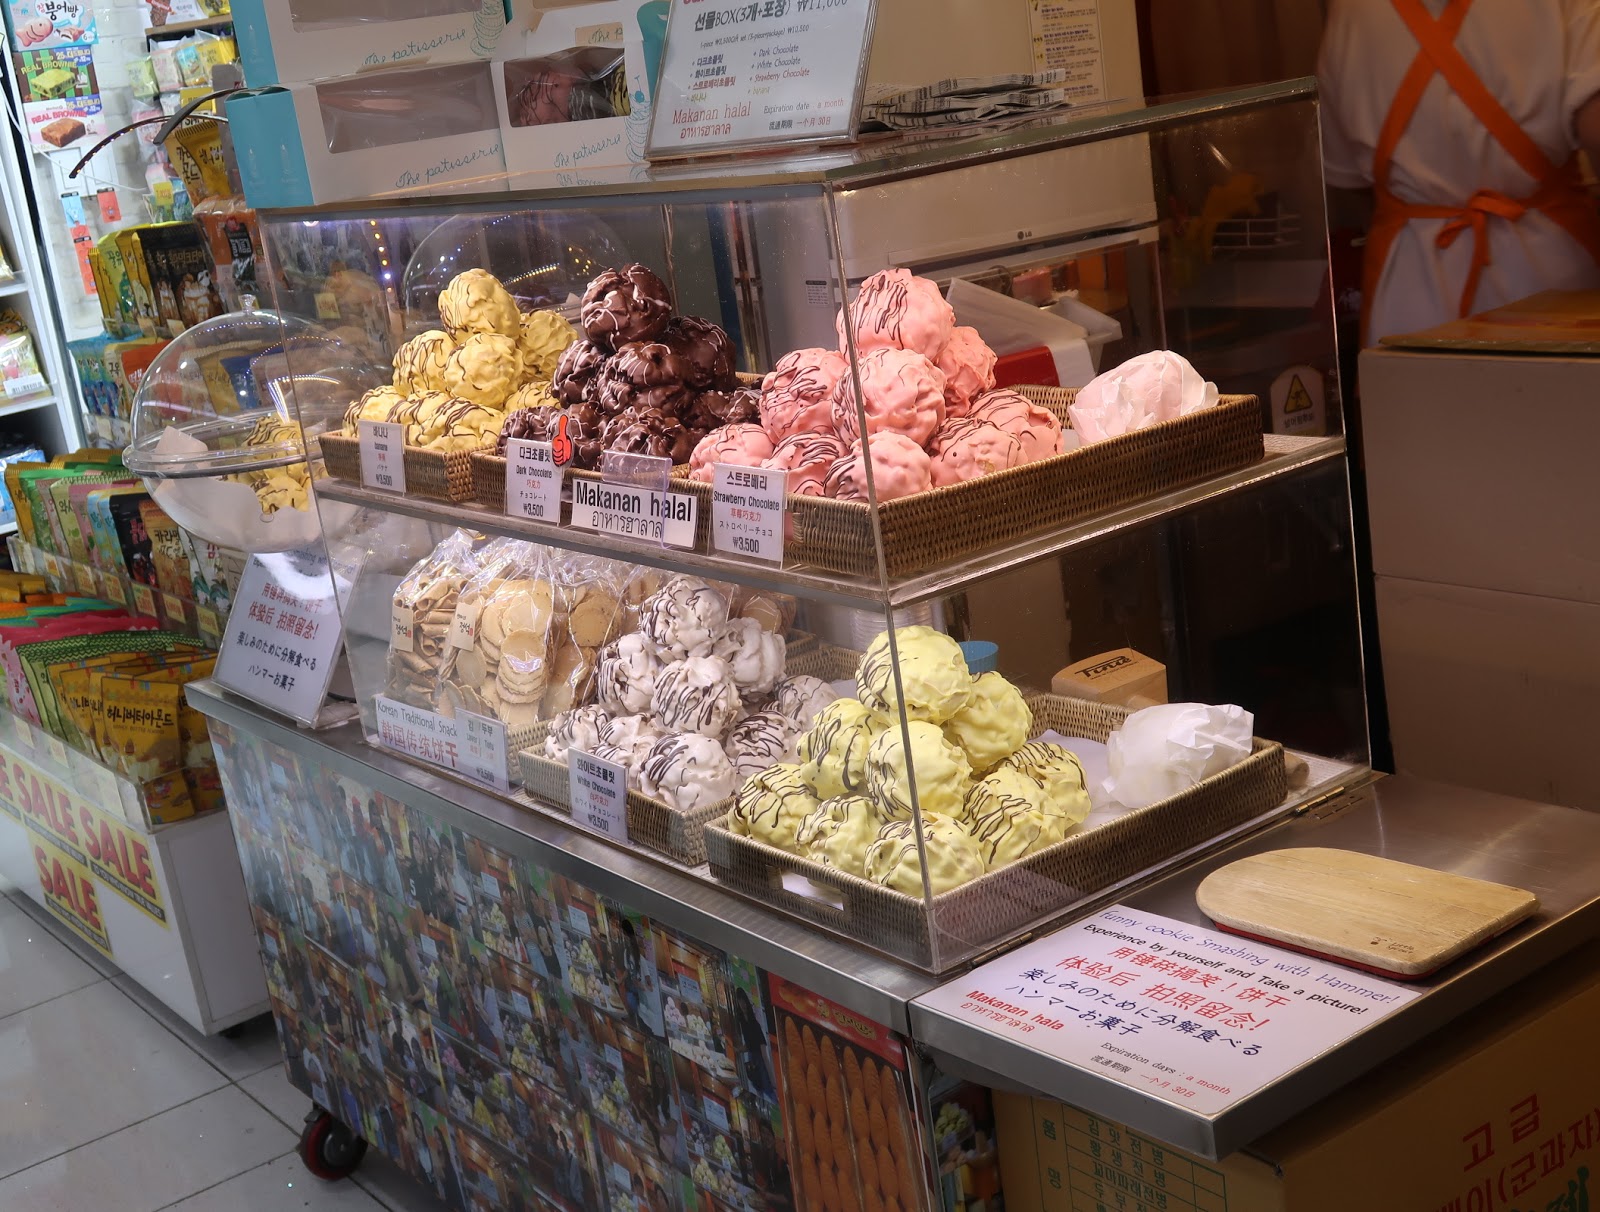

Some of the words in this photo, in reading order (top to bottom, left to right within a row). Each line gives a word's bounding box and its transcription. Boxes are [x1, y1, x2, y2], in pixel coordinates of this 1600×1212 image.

[45, 1, 79, 20] 붕어빵
[391, 27, 467, 60] patisserie
[759, 49, 770, 58] Dark
[773, 43, 799, 55] Chocolate
[20, 65, 41, 75] REAL
[42, 60, 77, 69] BROWNIE
[754, 71, 780, 82] Strawberry
[783, 67, 810, 78] Chocolate
[757, 60, 772, 70] White
[774, 56, 800, 67] Chocolate
[31, 114, 52, 124] REAL
[52, 110, 88, 119] BROWNIE
[672, 107, 718, 125] Makanan
[724, 101, 751, 119] halal
[764, 104, 793, 115] Expiration
[796, 102, 810, 111] date
[824, 98, 844, 108] month
[554, 151, 569, 168] The
[572, 134, 622, 166] patisserie
[395, 170, 422, 188] The
[426, 143, 501, 179] patisserie
[372, 426, 388, 439] 바나나
[376, 473, 392, 486] ₩3,500
[516, 465, 526, 475] Dark
[528, 466, 552, 478] Chocolate
[726, 471, 768, 491] 스트로베리
[519, 490, 547, 501] チョコレート
[526, 479, 541, 489] 巧克力
[523, 503, 544, 517] ₩3,500
[576, 481, 641, 514] Makanan
[650, 492, 692, 522] halal
[713, 491, 746, 506] Strawberry
[748, 496, 780, 511] Chocolate
[730, 507, 762, 522] 草莓巧克力
[719, 519, 773, 537] ストロベリーチョコ
[732, 536, 760, 554] ₩3,500
[248, 601, 275, 626] 体验后
[236, 631, 317, 671] 楽しみのために分解食べる
[248, 664, 295, 692] ハンマーお菓子
[107, 705, 174, 728] 허니버터아몬드
[377, 699, 399, 720] Korean
[400, 706, 436, 732] Traditional
[438, 719, 458, 738] Snack
[381, 718, 459, 768] 韩国传统饼干
[577, 774, 591, 788] White
[591, 781, 616, 799] Chocolate
[13, 763, 79, 846] SALE
[79, 805, 157, 900] SALE
[587, 813, 609, 832] ₩3,500
[34, 846, 102, 931] SALE
[1083, 923, 1147, 946] Experience
[1149, 942, 1170, 953] by
[1165, 949, 1228, 970] yourself
[1223, 966, 1256, 979] and
[1257, 975, 1290, 991] Take
[1293, 988, 1306, 996] a
[1305, 992, 1369, 1016] picture!
[1099, 910, 1143, 927] funny
[1145, 924, 1195, 942] cookie
[1197, 936, 1270, 967] Smashing
[1274, 963, 1312, 978] with
[1315, 974, 1401, 1005] Hammer!
[1055, 955, 1141, 987] 体验后
[1139, 983, 1270, 1031] 拍照留念!
[965, 990, 1029, 1017] Makanan
[1030, 1013, 1066, 1031] hala
[1005, 985, 1143, 1036] ハンマーお菓子
[1019, 968, 1262, 1056] 楽しみのために分解食べる
[1100, 1042, 1150, 1065] Expiration
[1185, 1074, 1194, 1082] a
[1197, 1077, 1232, 1096] month
[1140, 1073, 1171, 1088] 一个月
[1171, 1085, 1197, 1098] 30日
